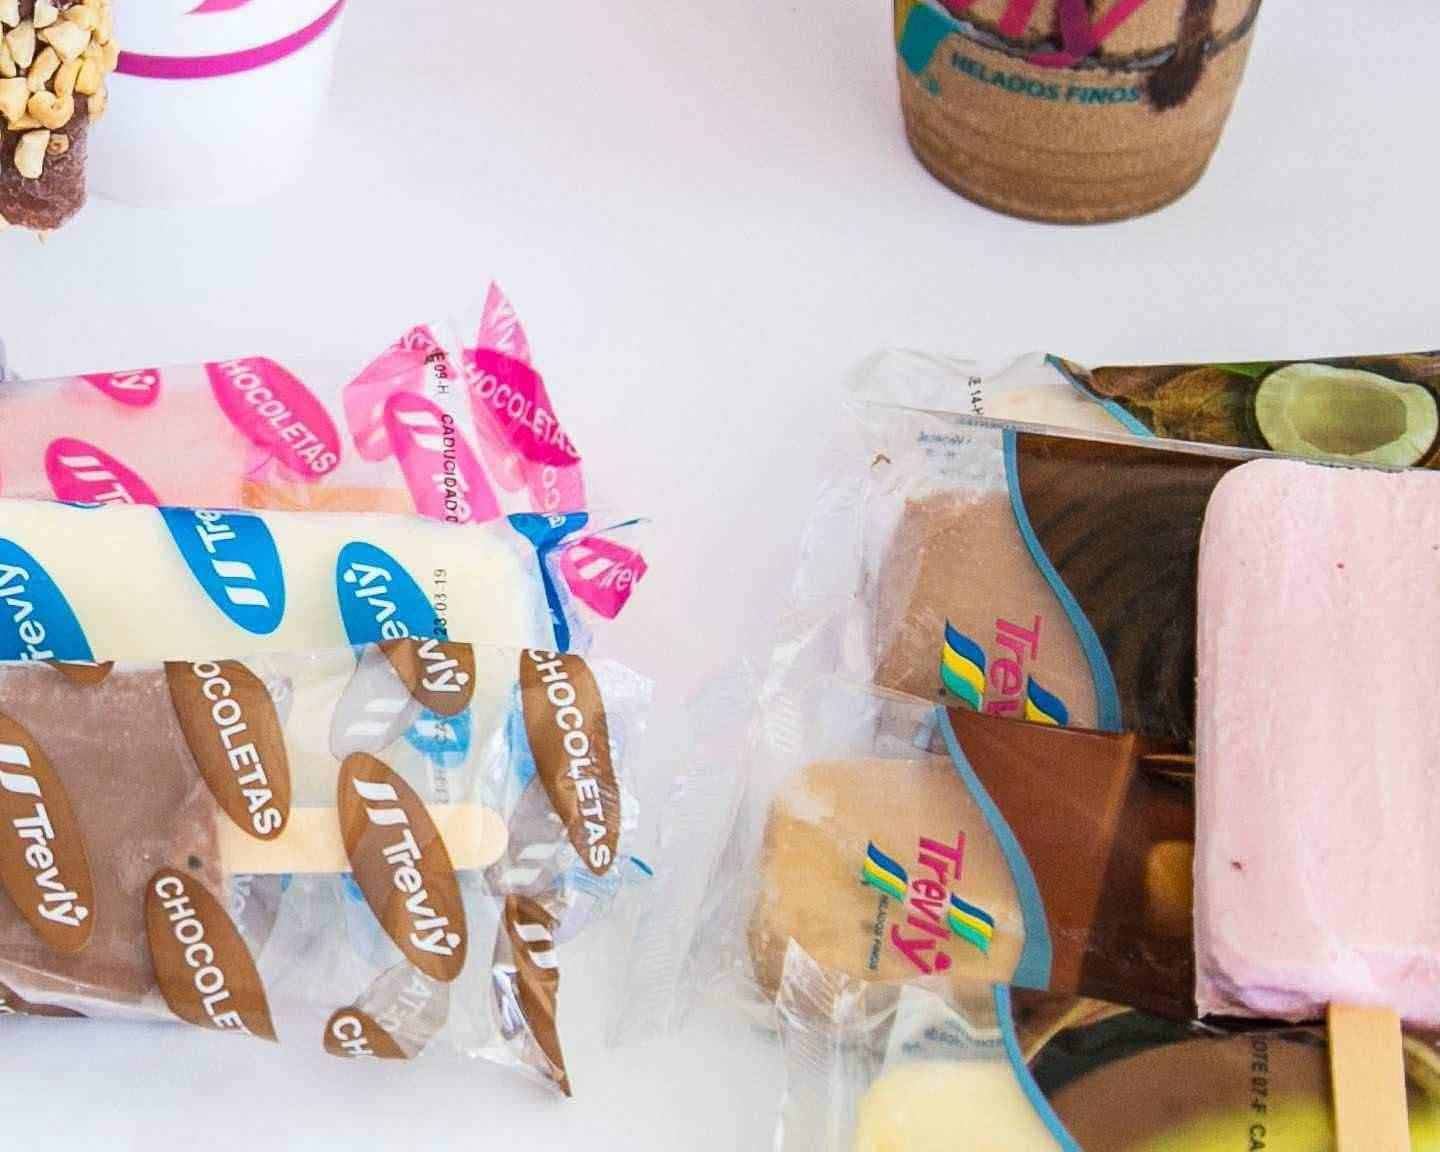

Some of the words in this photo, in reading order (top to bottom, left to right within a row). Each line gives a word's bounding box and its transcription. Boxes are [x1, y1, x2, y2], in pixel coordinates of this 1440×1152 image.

[949, 52, 1060, 101] HELADOS
[1065, 84, 1141, 104] FINOS
[440, 413, 459, 510] CADUCIDAD
[12, 802, 89, 928] Trevly
[381, 827, 461, 956] Trevly
[891, 830, 966, 974] Trevly
